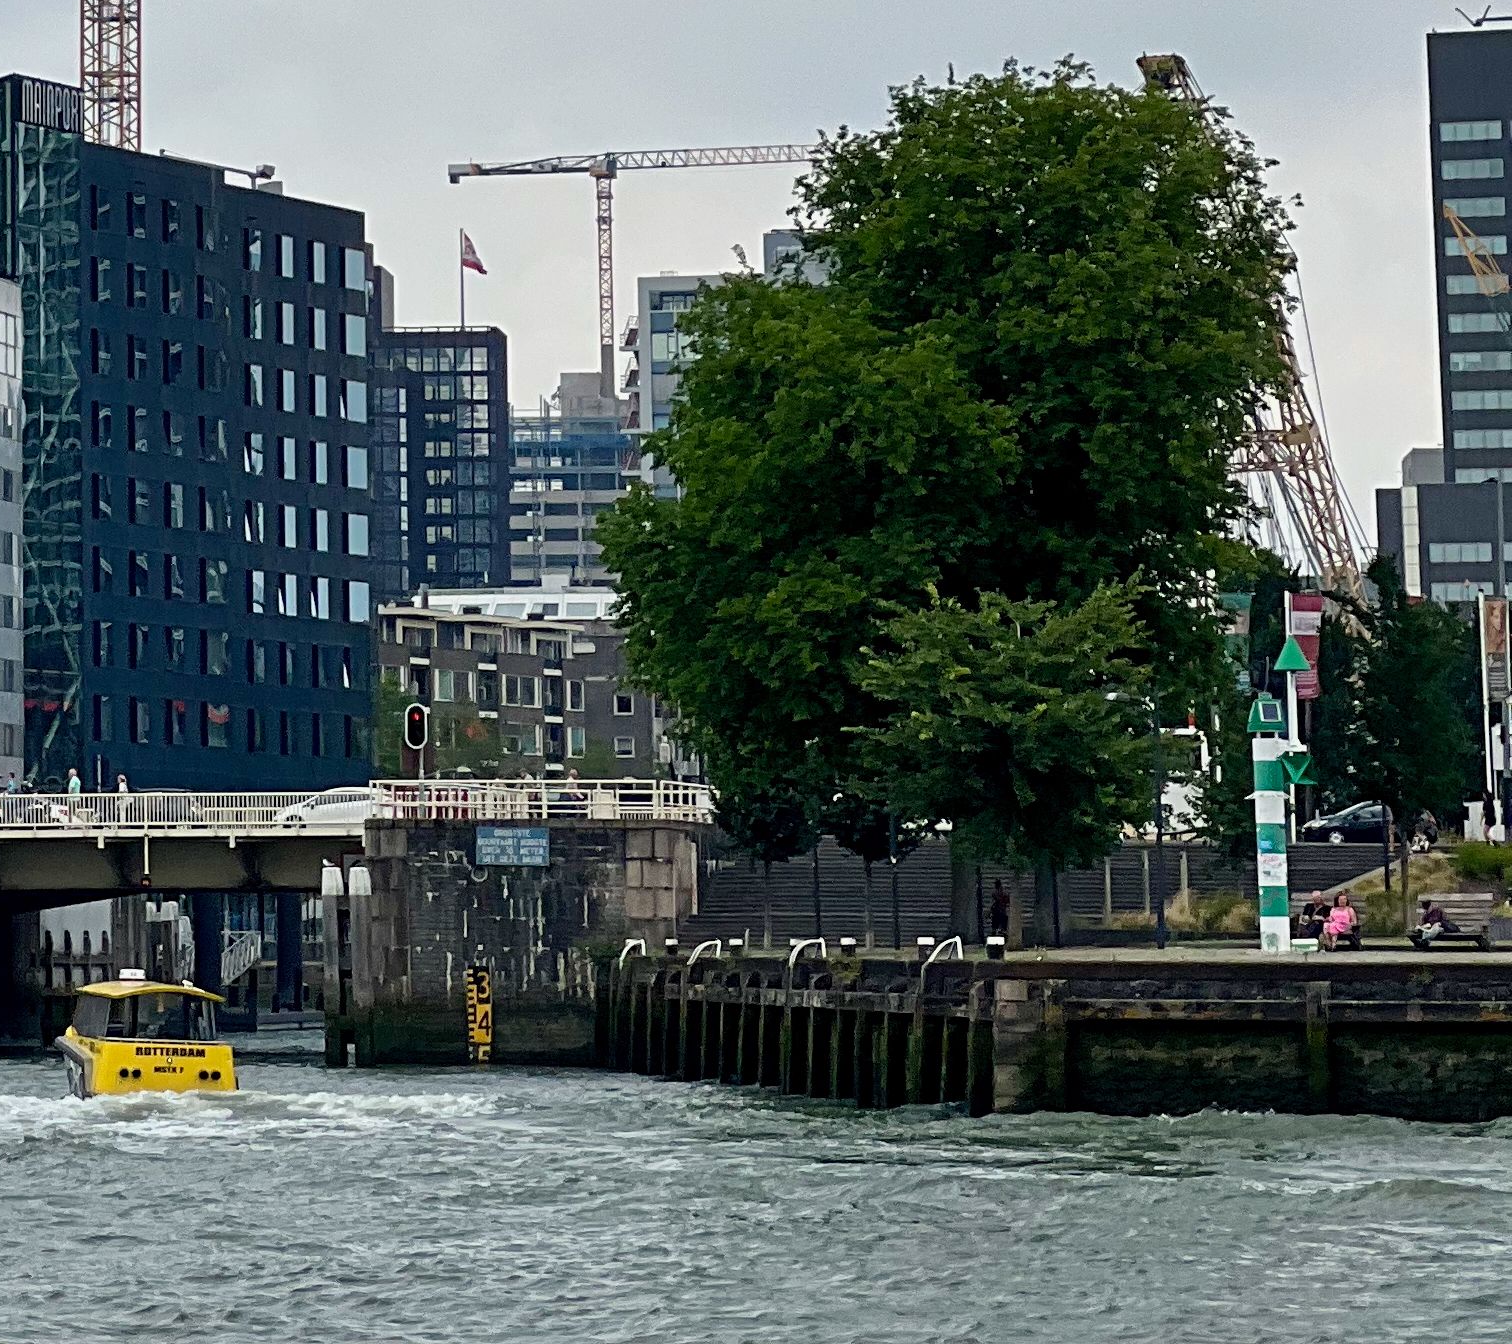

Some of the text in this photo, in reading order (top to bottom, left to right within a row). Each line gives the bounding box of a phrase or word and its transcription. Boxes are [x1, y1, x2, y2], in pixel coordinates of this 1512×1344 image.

[21, 79, 85, 134] MAINPORT
[476, 971, 490, 1000] 3
[477, 1010, 492, 1037] 4
[135, 1046, 206, 1058] ROTTERDAM
